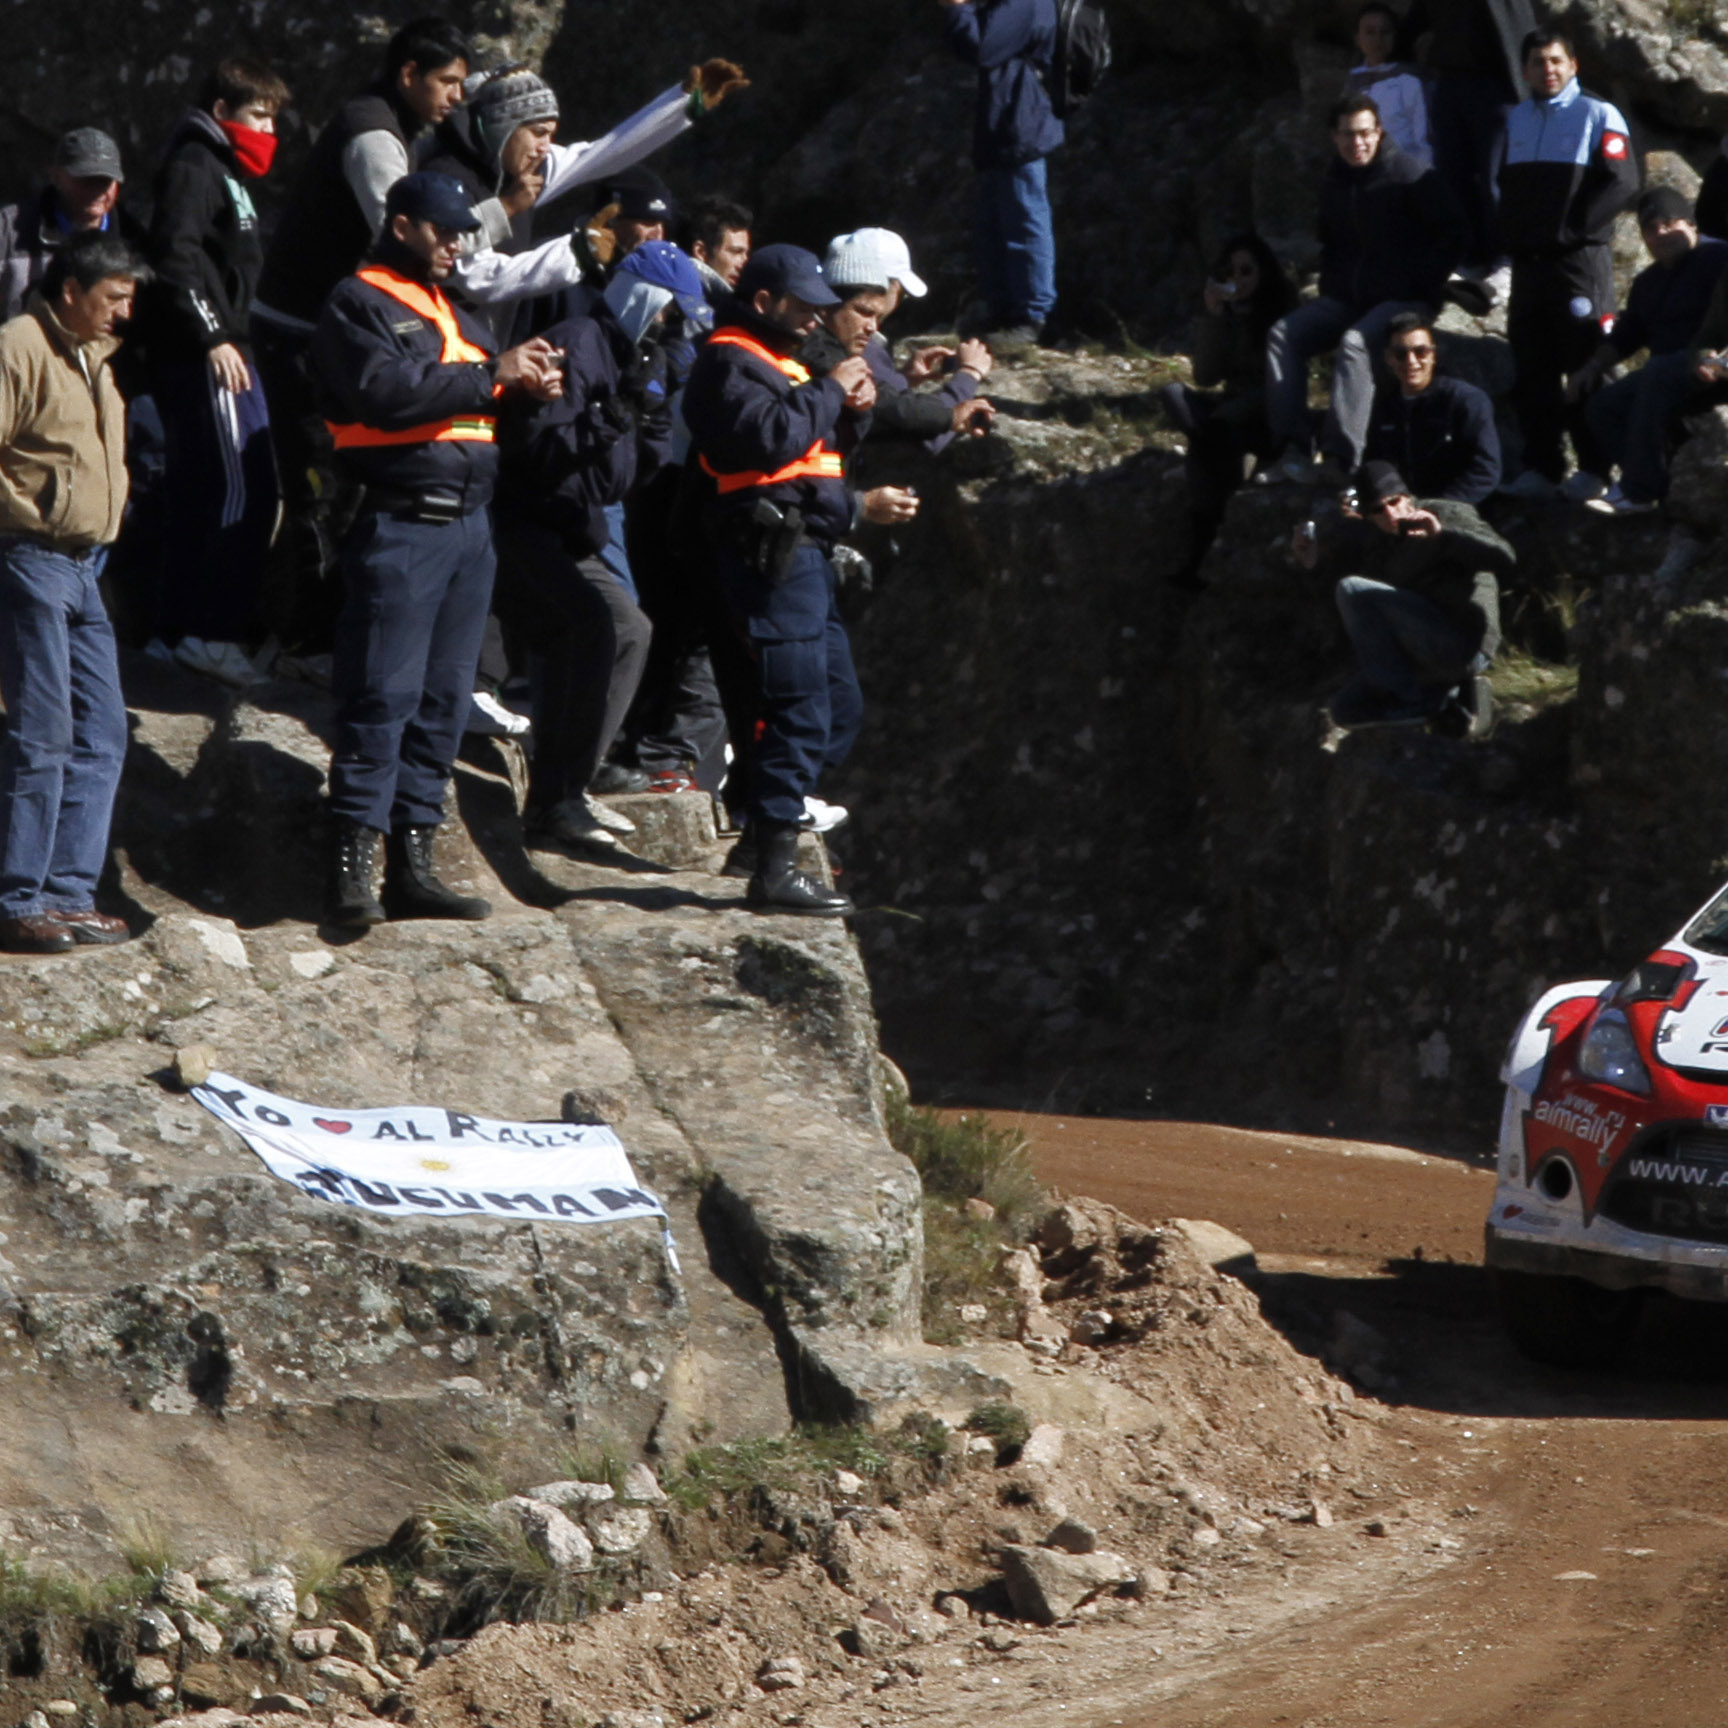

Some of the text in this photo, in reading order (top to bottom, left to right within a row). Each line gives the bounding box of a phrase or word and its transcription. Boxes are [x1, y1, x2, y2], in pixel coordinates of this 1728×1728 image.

[201, 1082, 292, 1128] YO
[372, 1118, 435, 1142] AL
[1533, 1099, 1619, 1154] almrally
[294, 1168, 658, 1218] TUCUMAN
